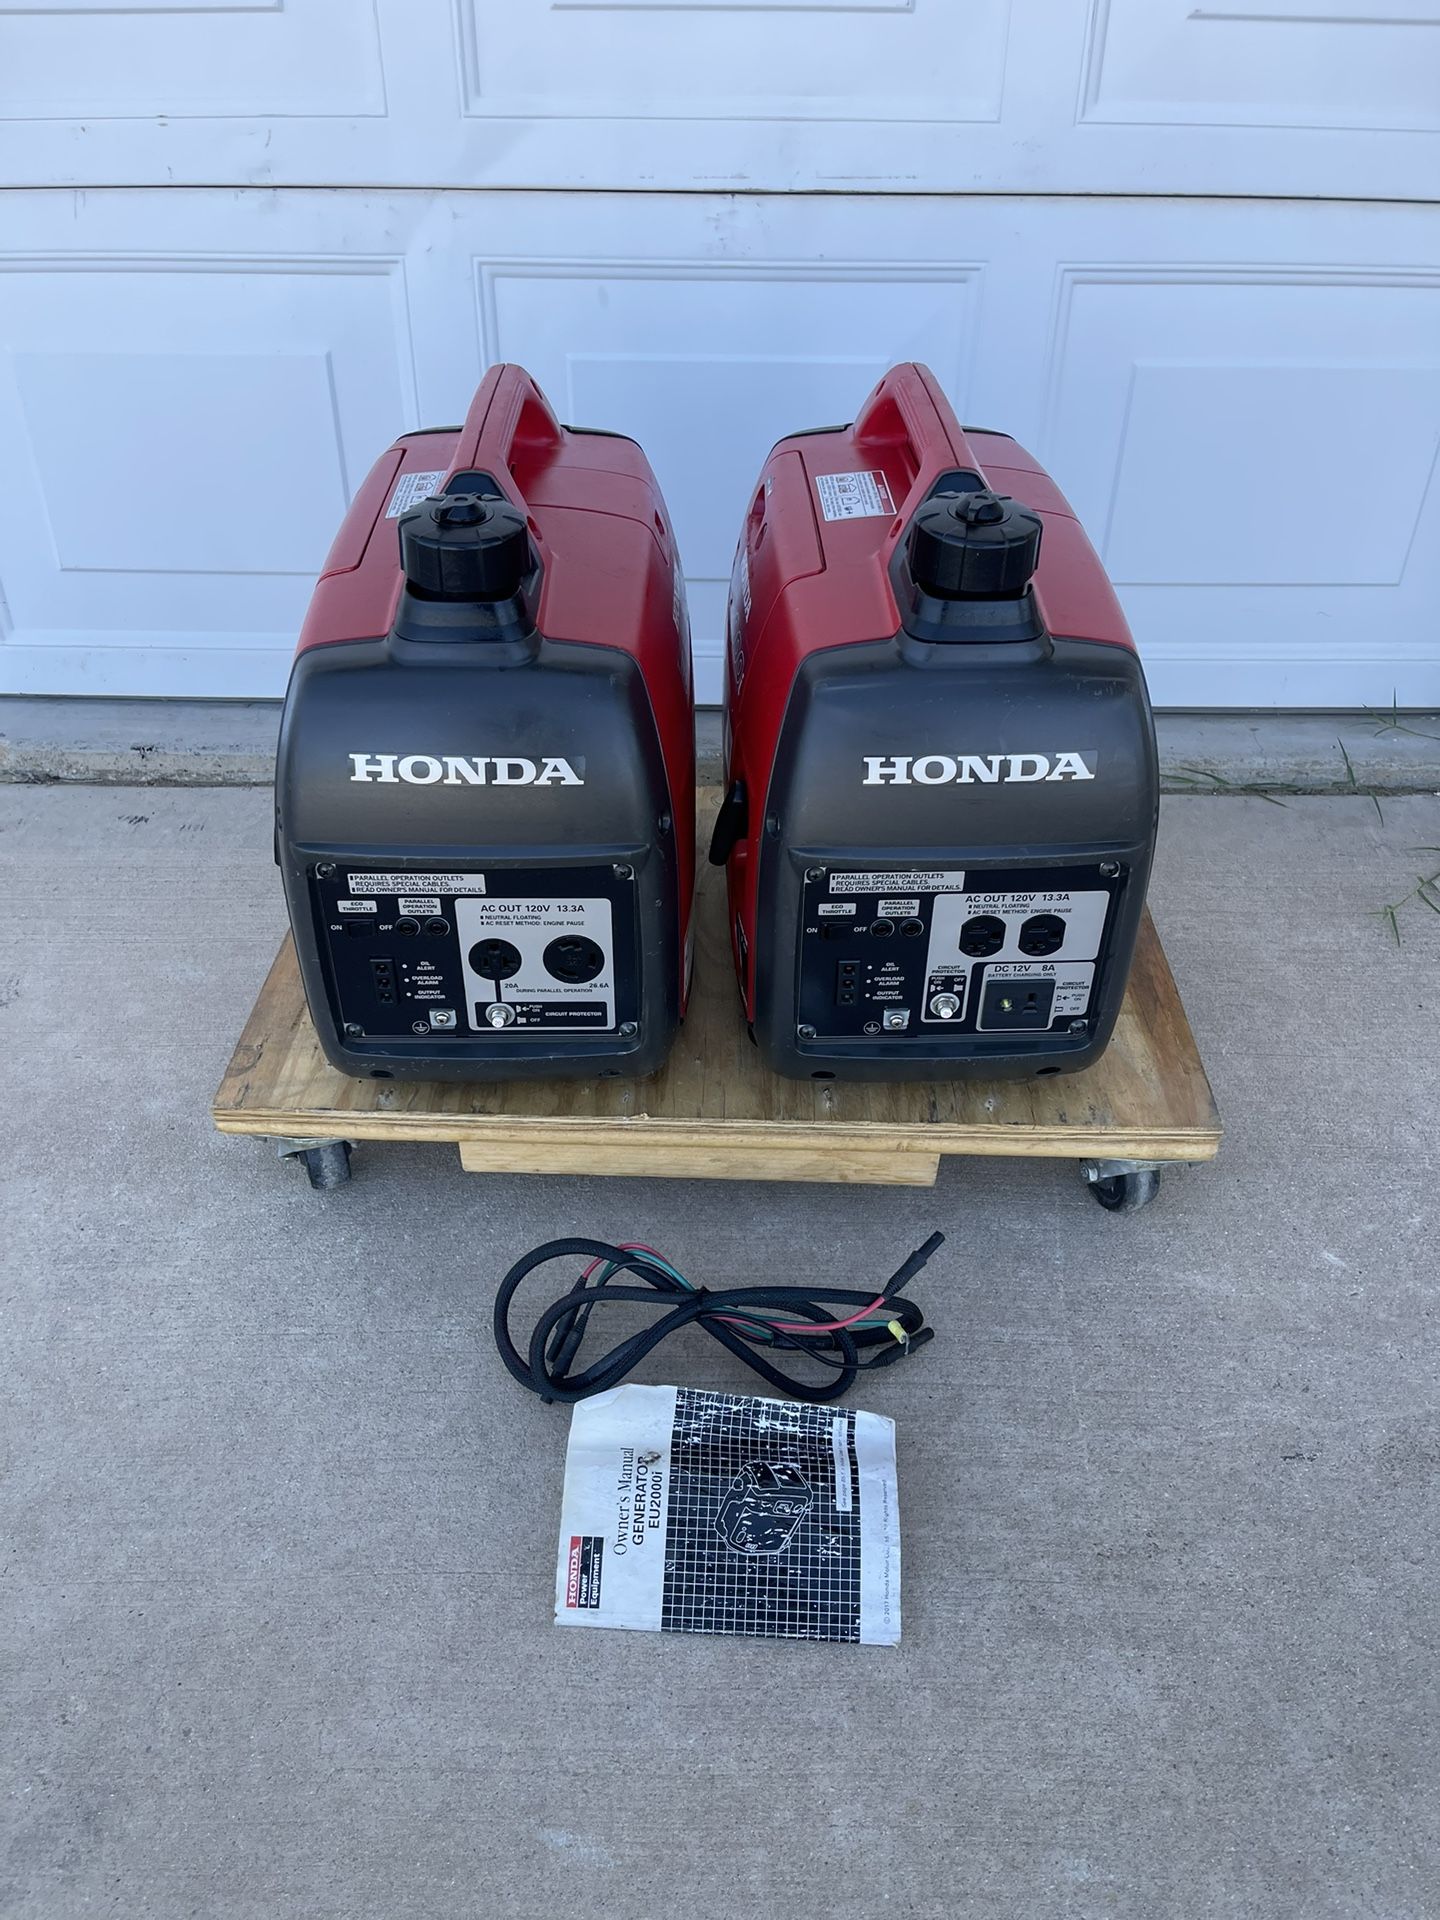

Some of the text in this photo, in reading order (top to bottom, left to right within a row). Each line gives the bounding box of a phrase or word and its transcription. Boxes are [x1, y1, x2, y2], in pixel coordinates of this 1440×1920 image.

[349, 753, 585, 785] HONDA
[863, 753, 1095, 785] HONDA
[480, 904, 585, 912] AC OUT 120V 13.3A
[965, 893, 1070, 903] AC OUT 120V 13.3A
[994, 965, 1009, 973] DC
[1041, 964, 1055, 972] 8A
[613, 1447, 634, 1556] Owner's Manual
[648, 1471, 663, 1529] EU2000i
[882, 1505, 890, 1522] Rights
[568, 1546, 580, 1605] HONDA
[579, 1574, 588, 1605] Power
[590, 1553, 601, 1605] Equipment
